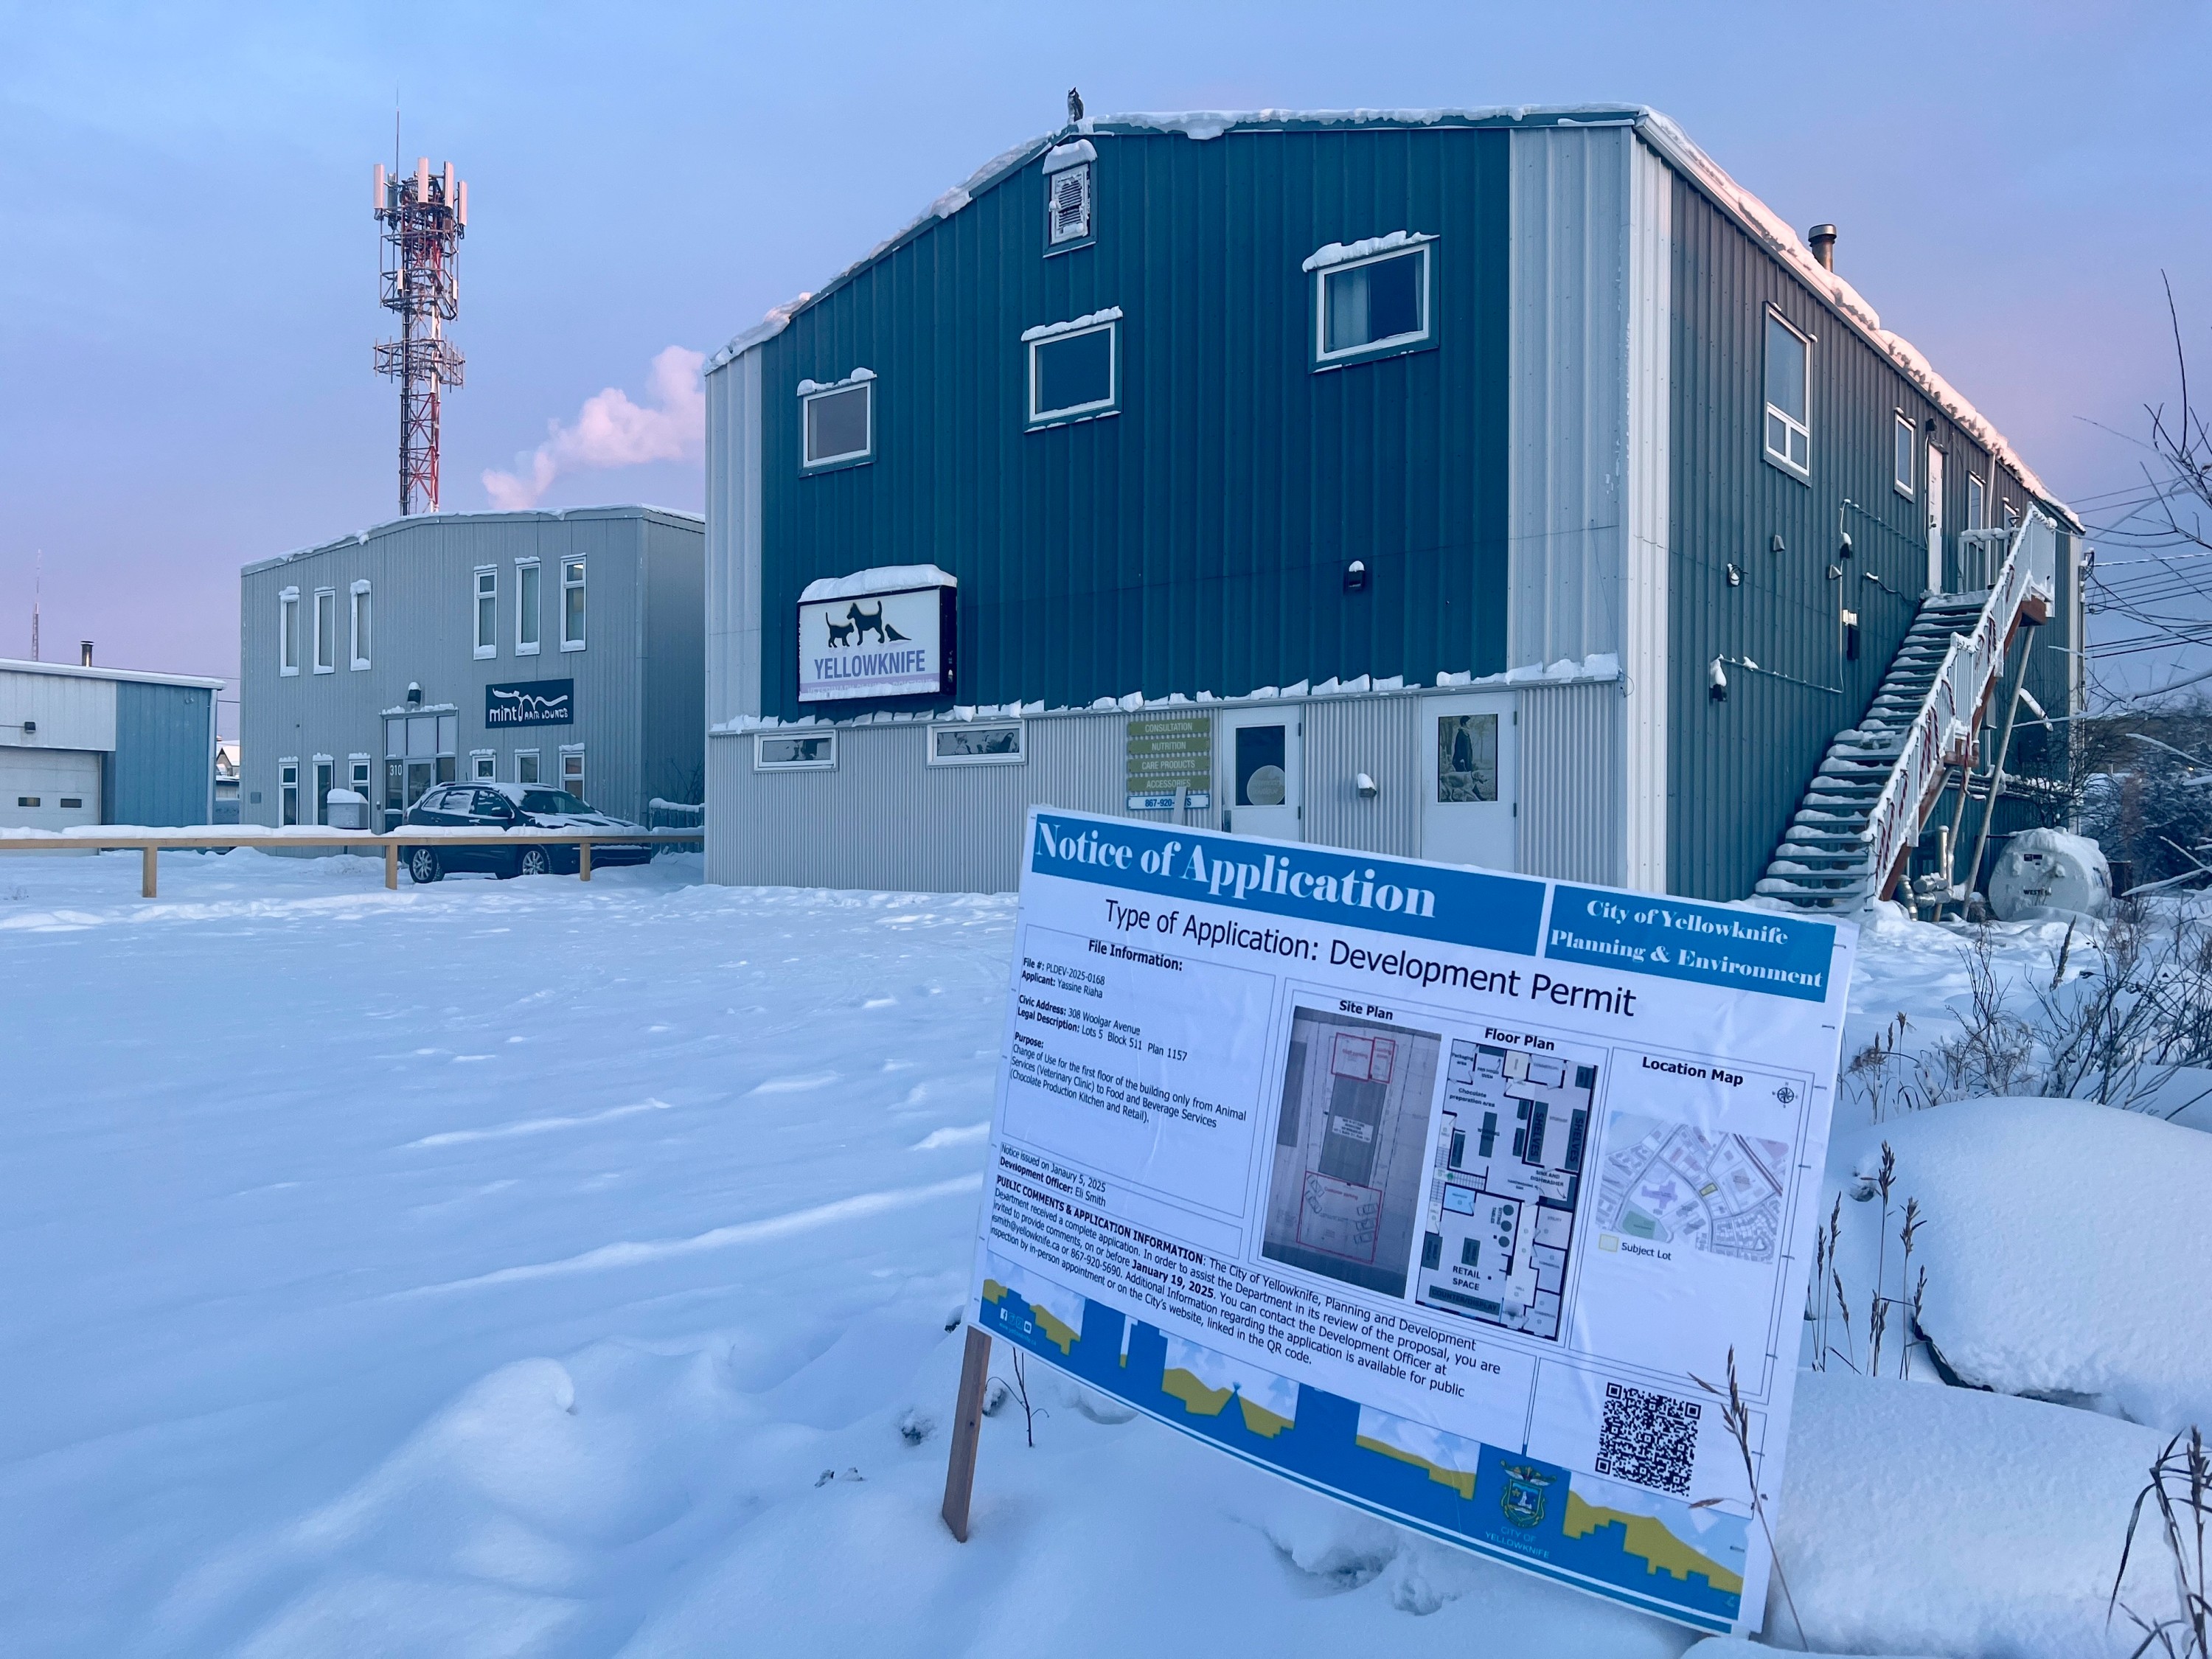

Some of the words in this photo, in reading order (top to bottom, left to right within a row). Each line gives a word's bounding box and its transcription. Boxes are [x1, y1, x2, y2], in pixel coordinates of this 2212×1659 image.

[814, 650, 925, 680] YELLOWKNIFE
[490, 705, 517, 722] mint
[1145, 723, 1192, 732] CONSULTATION
[1152, 742, 1186, 751] NUTRITION
[390, 765, 402, 776] 310
[1142, 762, 1158, 770] CARE
[1161, 760, 1195, 769] PRODUCTS
[1147, 779, 1191, 788] ACCESSORIES
[1035, 822, 1133, 869] Notice
[1141, 840, 1181, 877] of
[1180, 844, 1436, 918] Application
[1587, 900, 1629, 927] City
[1635, 908, 1659, 925] of
[1661, 910, 1789, 945] Yellowknife
[1088, 939, 1107, 955] File
[1109, 943, 1183, 971] Information:
[1106, 900, 1150, 931] Type
[1157, 914, 1179, 933] of
[1183, 915, 1318, 961] Application:
[1331, 939, 1520, 998] Development
[1531, 974, 1637, 1018] Permit
[1551, 930, 1645, 964] Planning
[1650, 945, 1671, 964] &
[1677, 949, 1823, 989] Environment
[1021, 970, 1056, 987] Applicant:
[1057, 978, 1082, 993] Yassine
[1083, 984, 1103, 998] Riaha
[1023, 957, 1035, 968] File
[1036, 961, 1045, 971] #:
[1046, 962, 1105, 986] PLDEV-2025-0168
[1018, 994, 1034, 1007] Civic
[1035, 999, 1066, 1016] Address:
[1068, 1007, 1081, 1020] 308
[1082, 1011, 1112, 1028] Woolgar
[1113, 1020, 1141, 1036] Avenue
[1339, 999, 1363, 1015] Site
[1366, 1004, 1393, 1020] Plan
[1014, 1031, 1044, 1048] Purpose:
[1017, 1006, 1035, 1020] Legal
[1036, 1012, 1079, 1033] Description:
[1082, 1024, 1096, 1037] Lots
[1098, 1029, 1103, 1039] 5
[1107, 1031, 1127, 1046] Block
[1129, 1037, 1141, 1050] 511
[1147, 1043, 1164, 1056] Plan
[1167, 1048, 1187, 1061] 1157
[1484, 1026, 1520, 1044] Floor
[1523, 1034, 1554, 1051] Plan
[1012, 1043, 1035, 1060] Change
[1044, 1053, 1057, 1065] Use
[1069, 1061, 1080, 1073] the
[1082, 1065, 1096, 1078] first
[1115, 1076, 1124, 1086] of
[1125, 1078, 1138, 1091] the
[1139, 1081, 1170, 1102] building
[1172, 1093, 1190, 1107] only
[1192, 1096, 1213, 1112] from
[1214, 1104, 1247, 1121] Animal
[1642, 1056, 1706, 1079] Location
[1711, 1068, 1743, 1087] Map
[1009, 1068, 1042, 1088] (Chocolate
[1043, 1079, 1077, 1099] Production
[1079, 1091, 1105, 1108] Kitchen
[1106, 1102, 1121, 1113] and
[1122, 1105, 1149, 1124] Retail).
[1011, 1056, 1035, 1072] Services
[1037, 1064, 1072, 1086] (Veterinary
[1074, 1076, 1095, 1093] Clinic)
[1105, 1085, 1124, 1101] Food
[1126, 1093, 1141, 1105] and
[1142, 1096, 1180, 1118] Beverage
[1180, 1108, 1217, 1128] Services
[1458, 1088, 1487, 1098] Chocolate
[1531, 1111, 1545, 1157] SHELVES
[1570, 1117, 1584, 1163] SHELVES
[1001, 1143, 1020, 1159] Notice
[1020, 1150, 1041, 1166] issued
[1050, 1162, 1077, 1183] Janaury
[1078, 1173, 1084, 1184] 5,
[1088, 1177, 1106, 1193] 2025
[1045, 1175, 1073, 1193] Officer:
[1074, 1186, 1083, 1198] Eli
[1085, 1190, 1106, 1207] Smith
[1621, 1242, 1655, 1256] Subject
[1658, 1251, 1672, 1260] Lot
[1022, 1185, 1065, 1211] COMMENTS
[1065, 1204, 1072, 1216] &
[1074, 1207, 1131, 1239] APPLICATION
[1133, 1229, 1206, 1266] INFORMATION:
[1209, 1256, 1227, 1273] The
[1229, 1264, 1248, 1281] City
[1262, 1274, 1321, 1307] Yellowknife,
[1325, 1295, 1371, 1322] Planning
[1374, 1313, 1396, 1327] and
[1399, 1318, 1476, 1352] Development
[1453, 1265, 1481, 1279] RETAIL
[1020, 1214, 1045, 1231] provide
[1046, 1225, 1082, 1249] comments,
[1105, 1248, 1130, 1267] before
[1131, 1259, 1169, 1283] January
[1170, 1274, 1186, 1290] 19,
[1188, 1280, 1216, 1300] 2025.
[1220, 1291, 1237, 1307] You
[1239, 1301, 1256, 1314] can
[1259, 1308, 1295, 1328] contact
[1298, 1319, 1315, 1334] the
[1318, 1325, 1390, 1358] Development
[1393, 1349, 1432, 1370] Officer
[1030, 1204, 1057, 1222] received
[1065, 1220, 1097, 1239] complete
[1098, 1233, 1140, 1256] application.
[1154, 1255, 1177, 1270] order
[1189, 1268, 1215, 1284] assist
[1217, 1276, 1233, 1290] the
[1235, 1281, 1293, 1311] Department
[1307, 1306, 1320, 1320] its
[1323, 1313, 1358, 1332] review
[1376, 1328, 1394, 1343] the
[1397, 1337, 1447, 1359] proposal,
[1455, 1353, 1476, 1368] you
[1480, 1360, 1500, 1374] are
[1431, 1287, 1497, 1312] COUNTER/DISPLAY
[1453, 1278, 1480, 1291] SPACE
[1029, 1242, 1060, 1265] in-person
[1061, 1259, 1105, 1286] appointment
[1130, 1287, 1143, 1301] the
[1144, 1293, 1166, 1310] City's
[1169, 1304, 1203, 1327] website,
[1207, 1316, 1234, 1337] linked
[1248, 1332, 1265, 1347] the
[1267, 1339, 1281, 1354] QR
[1284, 1348, 1310, 1363] code.
[1070, 1248, 1121, 1277] 867-920-5690.
[1124, 1270, 1165, 1295] Additional
[1166, 1287, 1217, 1315] Information
[1220, 1309, 1265, 1334] regarding
[1267, 1324, 1284, 1339] the
[1287, 1332, 1342, 1359] application
[1357, 1356, 1406, 1380] available
[1410, 1370, 1427, 1385] for
[1429, 1379, 1465, 1397] public
[1486, 1531, 1550, 1559] YELLOWKNIFE
[1501, 1526, 1522, 1538] CITY
[1523, 1534, 1537, 1543] OF
